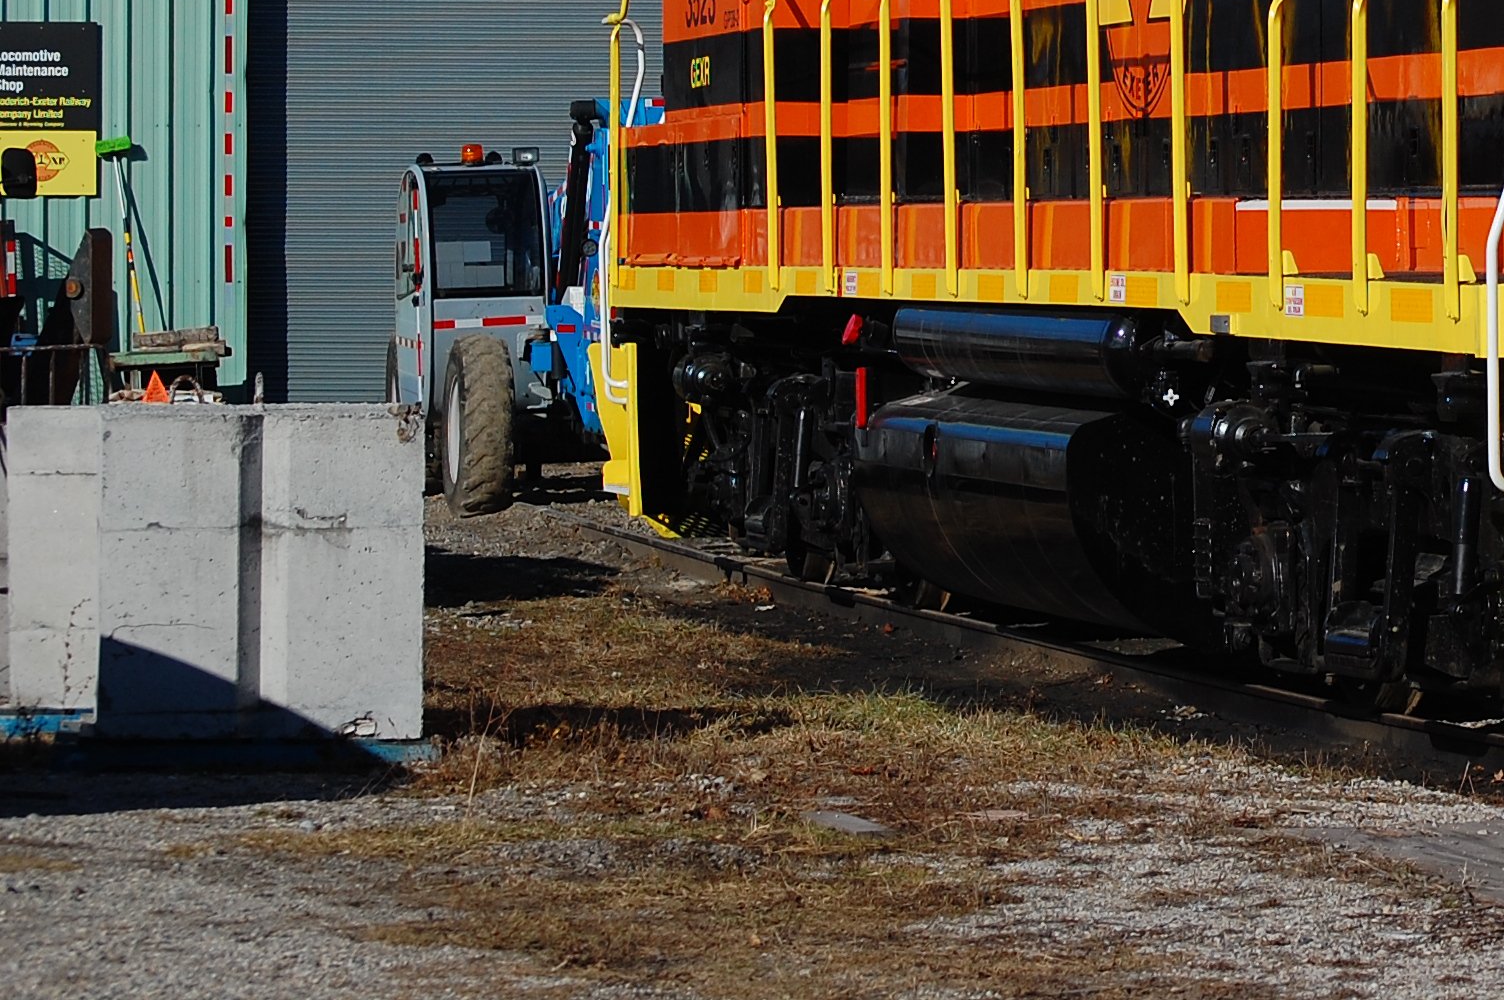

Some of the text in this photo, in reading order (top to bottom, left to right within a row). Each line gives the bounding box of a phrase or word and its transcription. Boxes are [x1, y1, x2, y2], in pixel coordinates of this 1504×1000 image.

[0, 49, 61, 62] ocomotive
[690, 55, 711, 89] GEXR
[0, 97, 91, 108] oderich-Exeter Railway
[0, 109, 63, 120] ompany Limited
